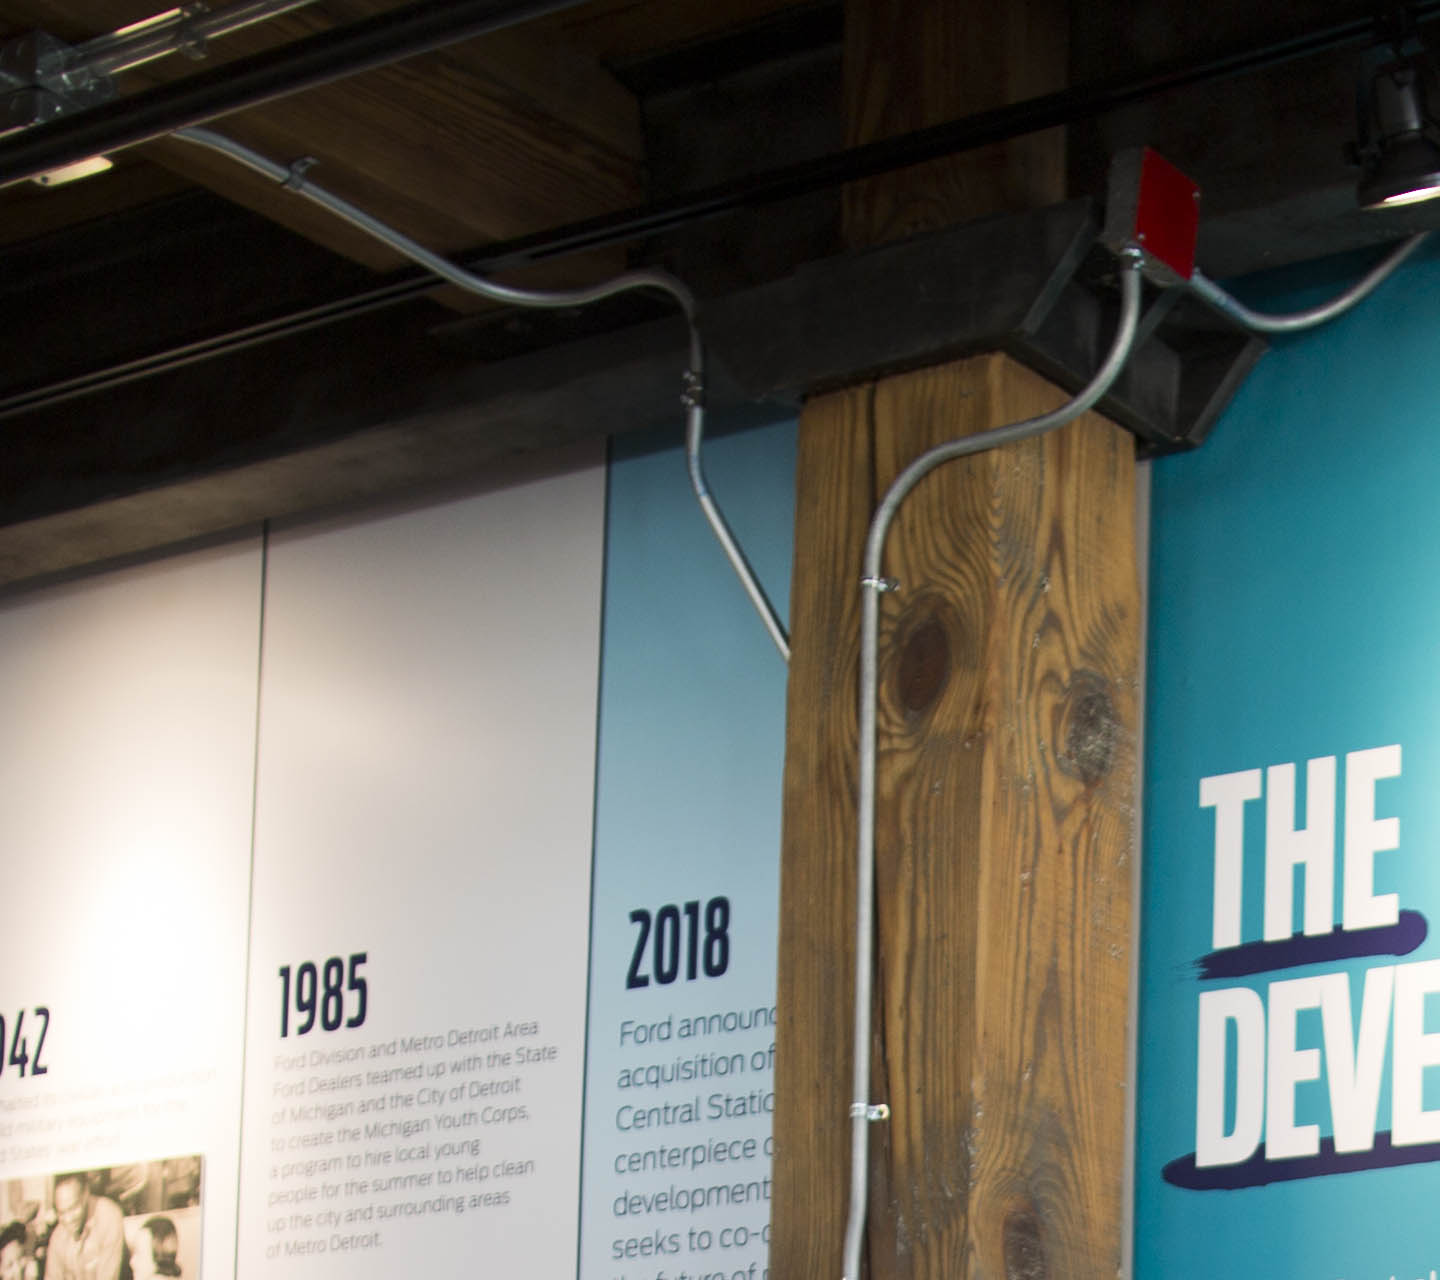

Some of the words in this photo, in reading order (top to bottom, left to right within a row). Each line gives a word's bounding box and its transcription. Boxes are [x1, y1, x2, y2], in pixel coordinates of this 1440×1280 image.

[1199, 744, 1402, 950] THE
[625, 896, 732, 990] 2018
[278, 951, 369, 1038] 1985
[619, 1014, 673, 1047] Ford
[617, 1051, 745, 1089] acquisition
[616, 1096, 700, 1132] Central
[614, 1137, 756, 1174] centerpiece
[613, 1175, 772, 1217] development
[612, 1229, 681, 1260] seeks
[688, 1226, 713, 1252] to
